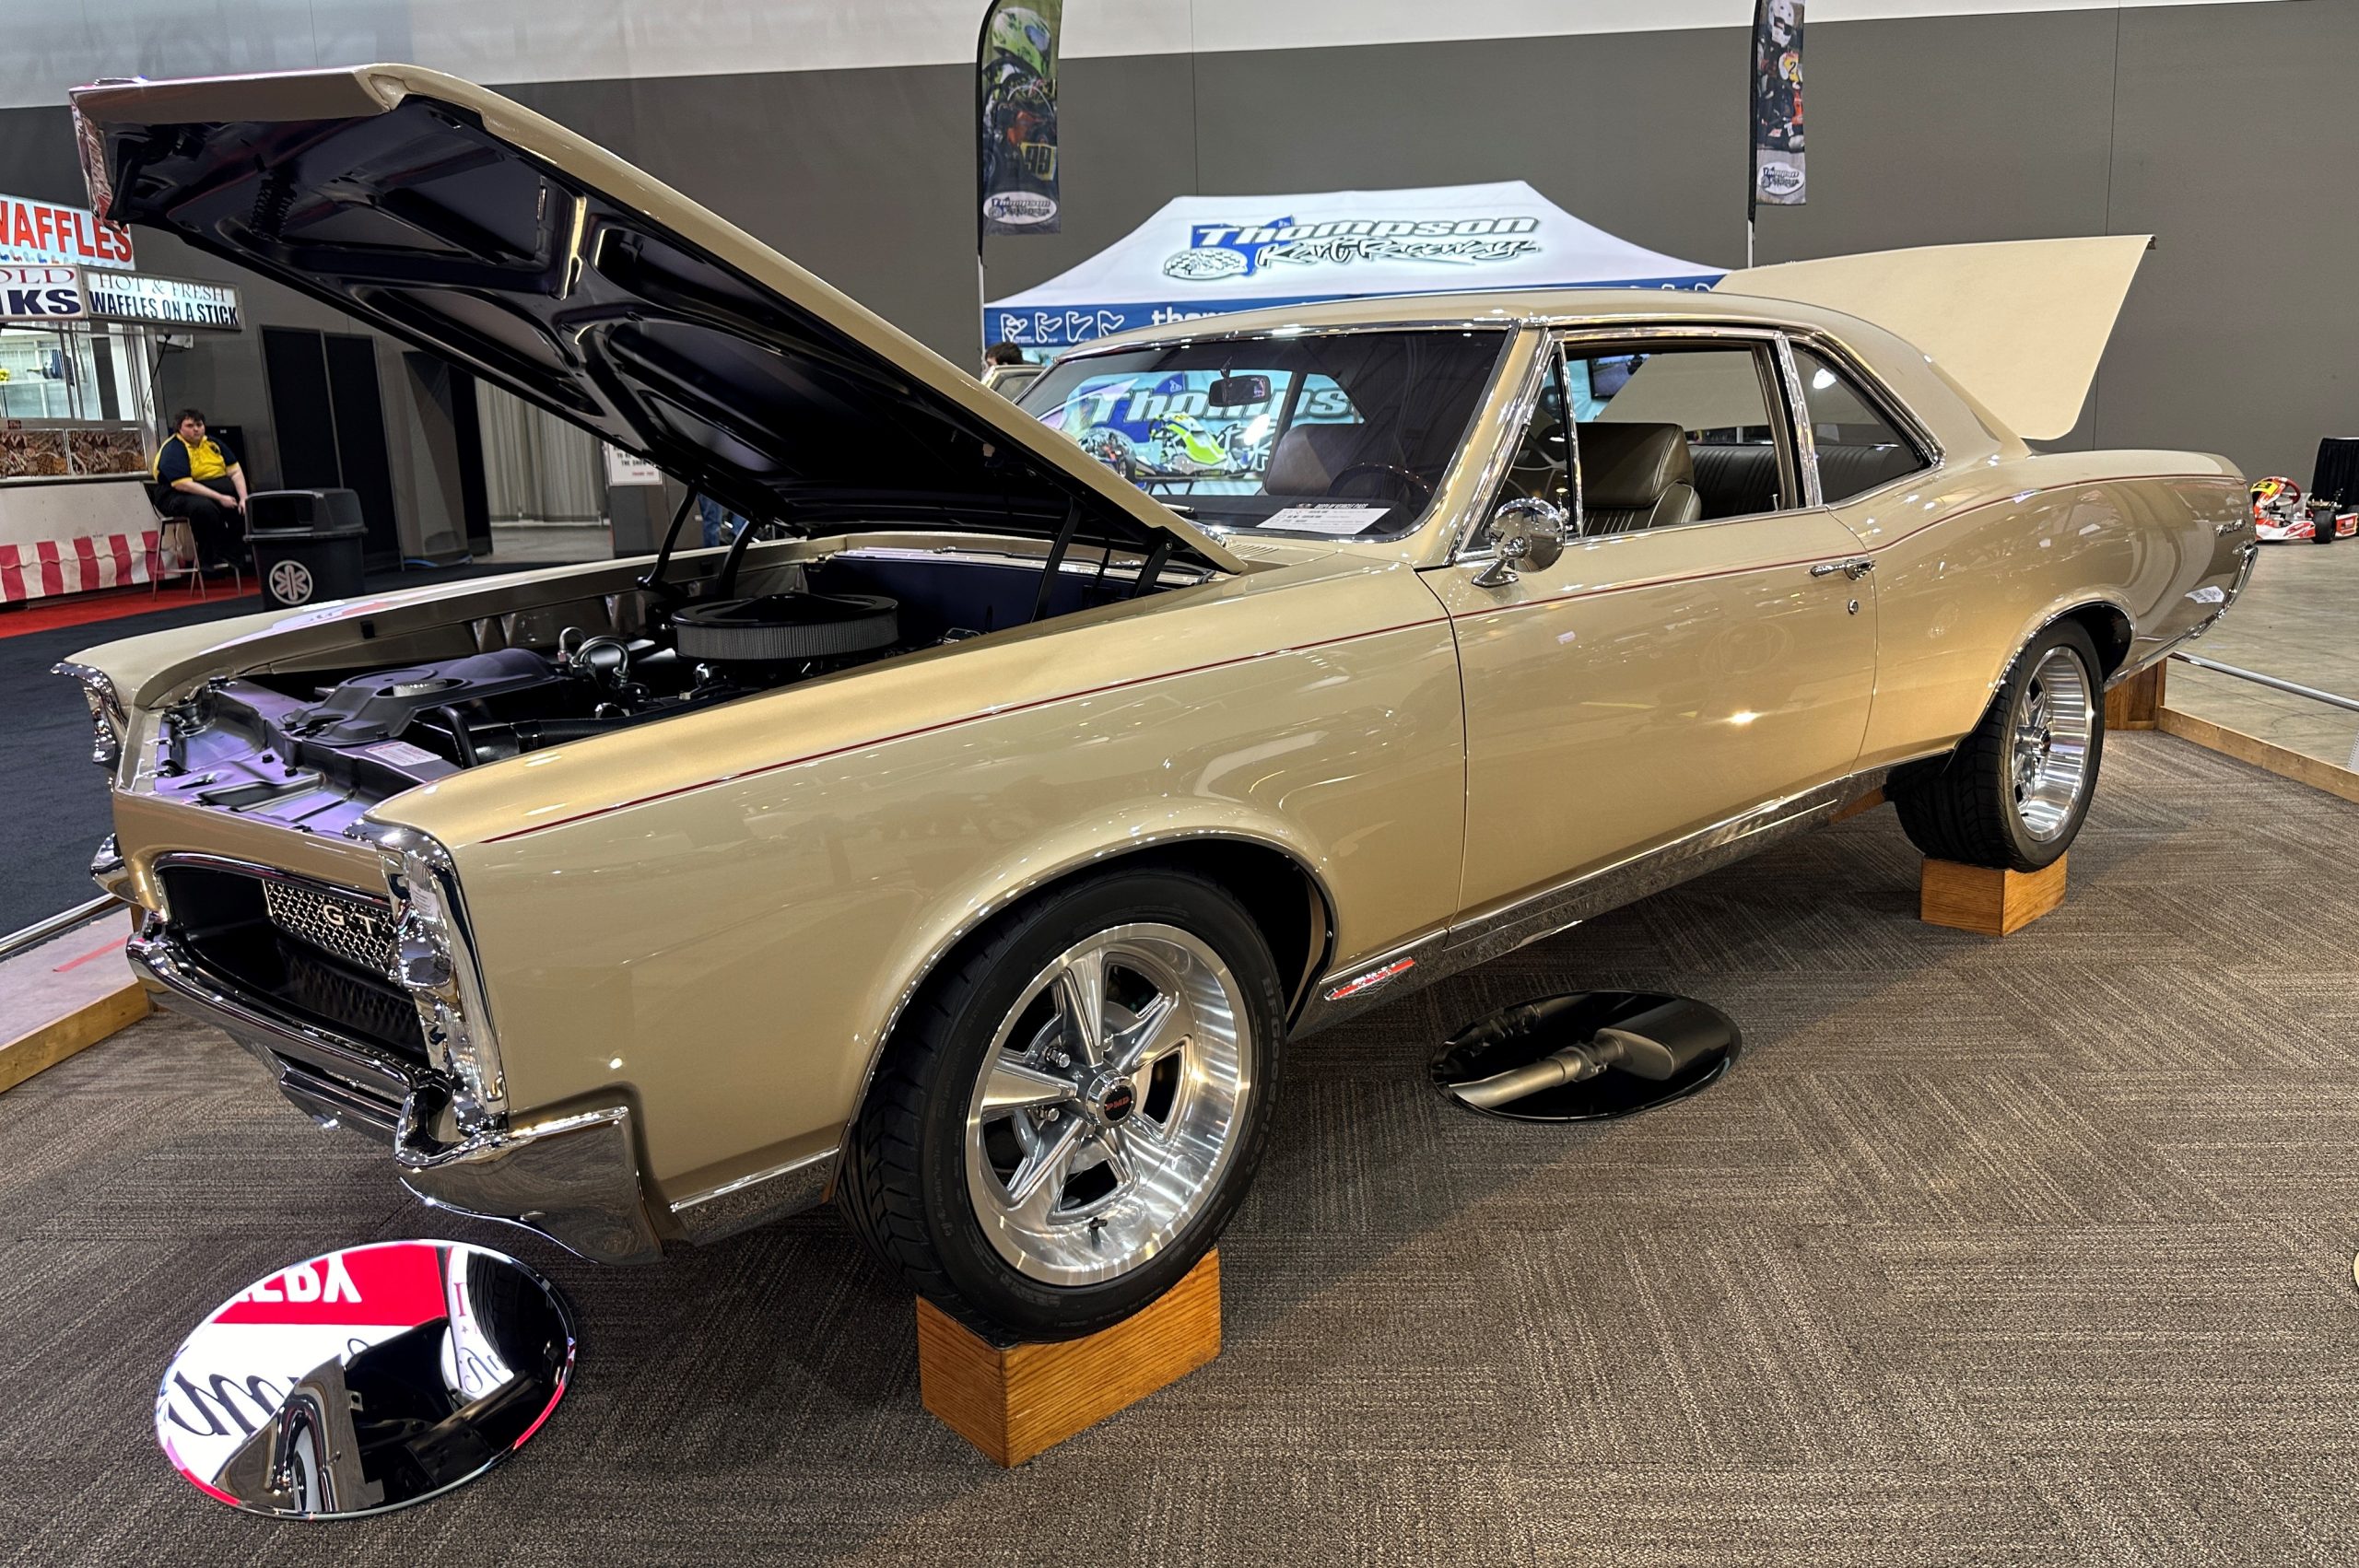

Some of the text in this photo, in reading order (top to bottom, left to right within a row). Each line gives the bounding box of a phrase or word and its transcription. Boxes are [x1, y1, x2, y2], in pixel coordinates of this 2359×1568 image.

[0, 200, 133, 263] AFFLES
[1197, 216, 1540, 246] Thompson
[0, 288, 81, 315] KS
[99, 274, 226, 302] HOT & FRESH
[88, 291, 239, 325] WAFFLES ON A STICK
[323, 904, 377, 935] GT
